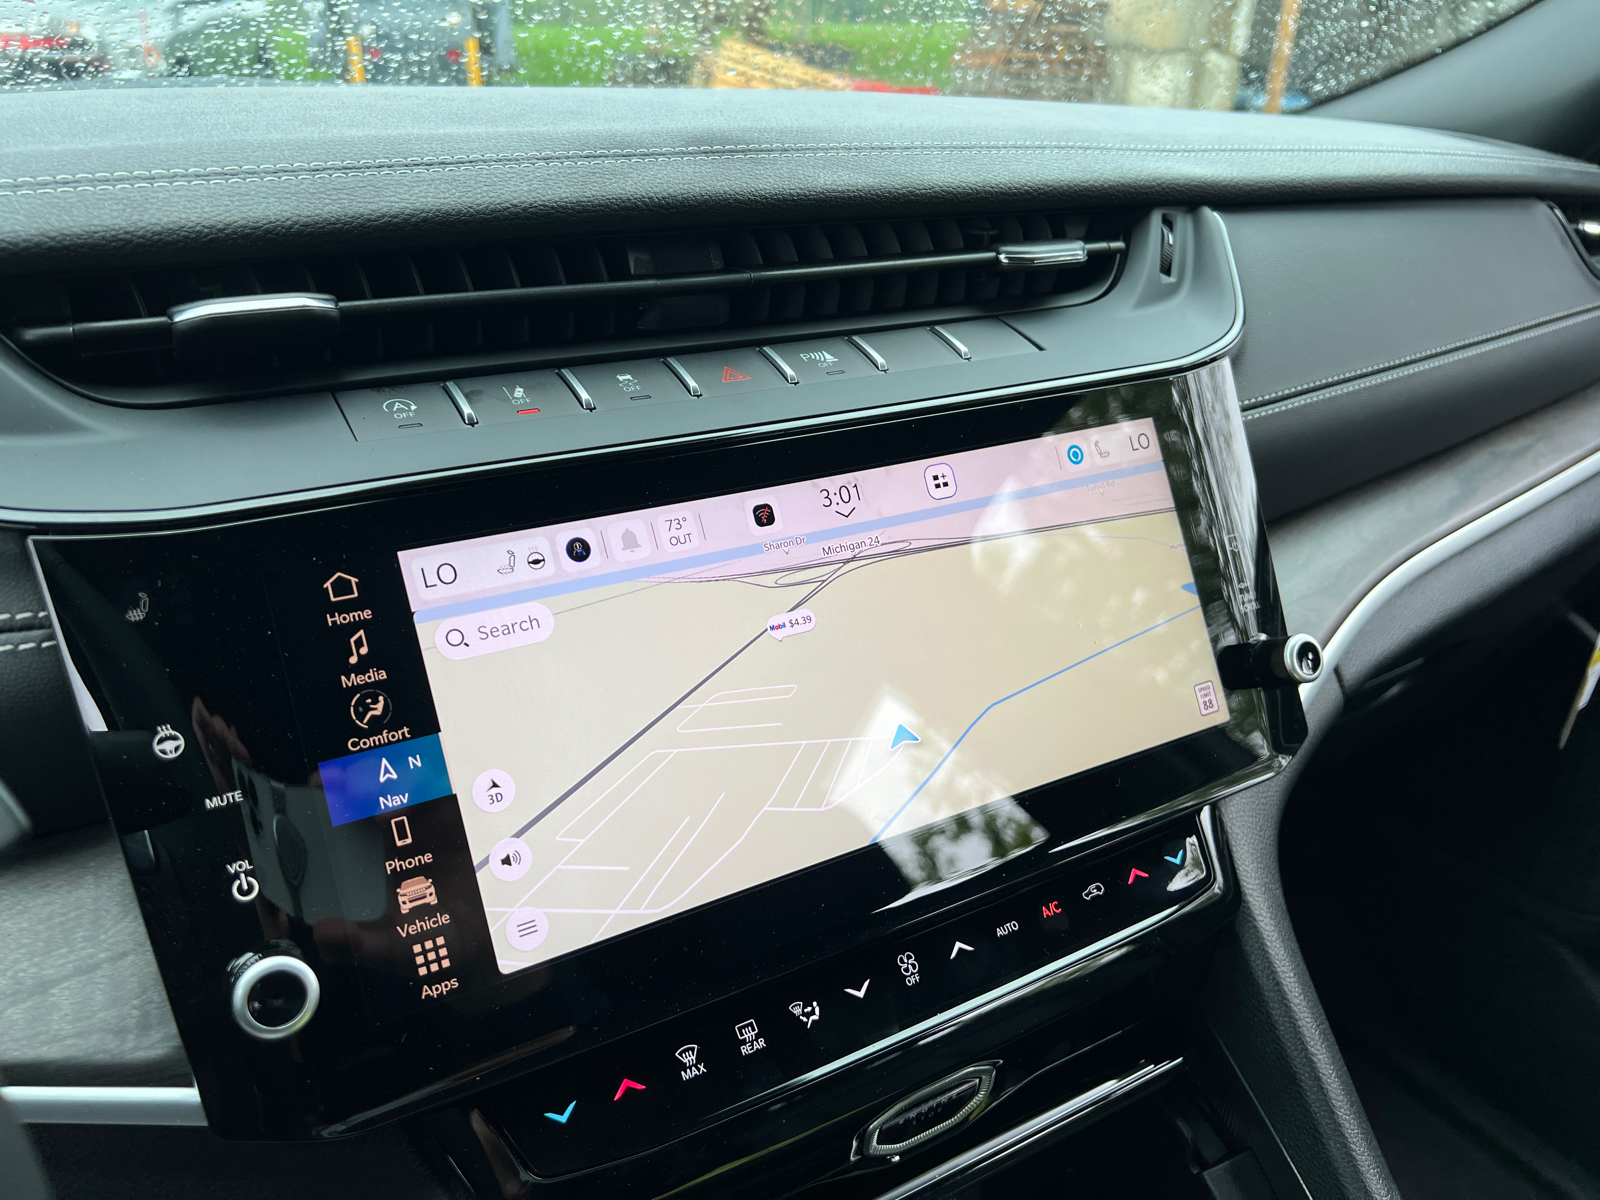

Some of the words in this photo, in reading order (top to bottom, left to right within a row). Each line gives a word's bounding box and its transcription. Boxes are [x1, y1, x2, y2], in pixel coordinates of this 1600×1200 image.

[1129, 433, 1150, 452] LO
[1106, 480, 1115, 488] Rd
[819, 483, 861, 508] 3:01
[664, 516, 687, 532] 73°
[669, 532, 693, 547] OUT
[763, 538, 795, 552] Sharon
[795, 536, 806, 546] Dr
[821, 540, 866, 556] Michigan
[867, 535, 881, 546] 24
[421, 562, 458, 589] LO
[326, 607, 372, 627] Home
[769, 622, 786, 632] Mobil
[788, 615, 812, 628] $4.39
[477, 615, 541, 641] Search
[341, 667, 387, 688] Media
[1202, 698, 1214, 710] 88
[347, 726, 411, 751] Comfort
[408, 754, 422, 770] N
[205, 790, 244, 810] MUTE
[378, 793, 409, 810] Nav
[488, 792, 504, 805] 3D
[226, 859, 253, 874] VOL
[385, 852, 433, 874] Phone
[1042, 901, 1062, 918] A/C
[396, 913, 451, 938] Vehicle
[996, 921, 1019, 938] AUTO
[421, 978, 459, 999] Apps
[905, 973, 920, 986] OFF
[740, 1038, 766, 1056] REAR
[680, 1063, 707, 1081] MAX
